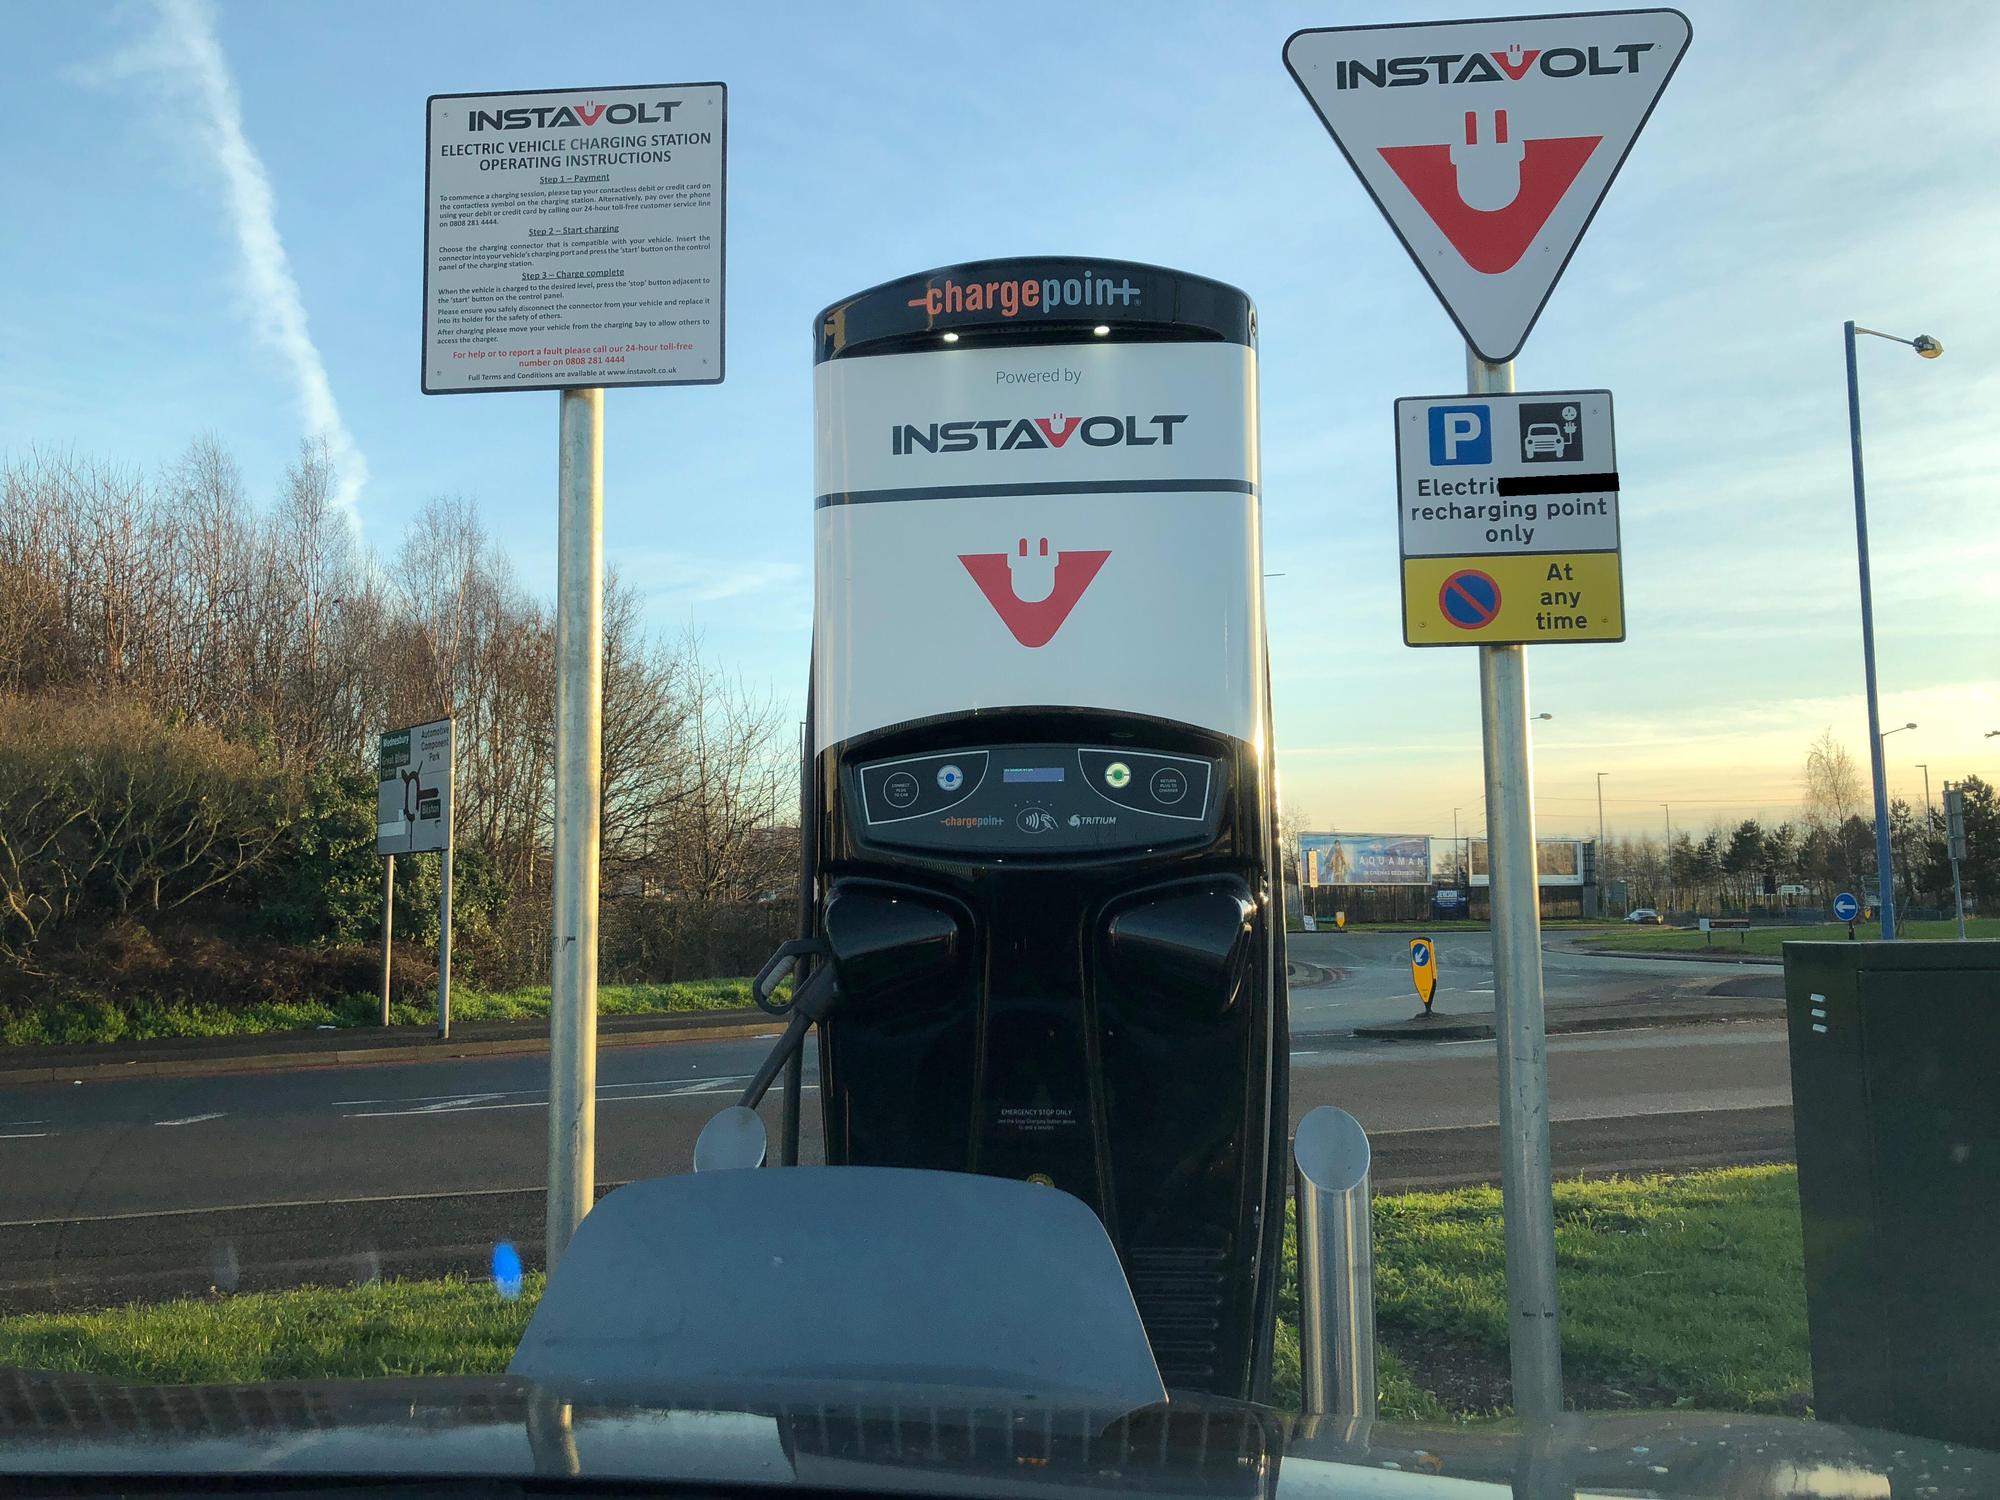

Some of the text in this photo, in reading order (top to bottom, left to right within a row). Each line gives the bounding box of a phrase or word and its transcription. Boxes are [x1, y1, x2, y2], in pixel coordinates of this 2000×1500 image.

[1336, 43, 1655, 90] INSTAVOLT
[469, 100, 683, 131] INSTAVOLT
[441, 132, 711, 157] ELECTRIC VEHICLE CHARGING STATION
[479, 150, 672, 171] OPERATING INSTRUCTIONS
[540, 176, 557, 185] Step
[574, 174, 610, 183] Payment
[491, 201, 515, 209] symbol
[541, 198, 572, 206] charging
[689, 192, 711, 200] phone
[440, 212, 457, 220] using
[548, 207, 569, 215] calling
[529, 228, 546, 237] Step
[563, 226, 582, 234] Start
[585, 225, 619, 234] charging
[522, 272, 539, 281] Step
[556, 270, 584, 280] Charge
[587, 269, 625, 278] complete
[502, 285, 528, 293] charged
[672, 278, 701, 286] adjacent
[908, 271, 1141, 316] chargepoint
[509, 314, 528, 322] safety
[456, 327, 484, 336] charging
[604, 322, 632, 330] charging
[635, 321, 646, 329] bay
[468, 351, 486, 359] help
[509, 349, 536, 358] report
[564, 347, 591, 356] please
[625, 344, 658, 352] 24-hour
[660, 343, 693, 351] toll-free
[565, 357, 586, 365] 0808
[607, 367, 677, 375] www.instavolt.co.uk
[995, 368, 1082, 384] Powered by
[892, 412, 1189, 455] INSTAVOLT
[1443, 412, 1482, 460] P
[1417, 478, 1508, 497] Electri
[1411, 497, 1608, 522] recharging point
[1485, 523, 1535, 545] only
[1546, 563, 1574, 581] At
[1540, 590, 1581, 608] any
[1536, 612, 1588, 630] time
[421, 726, 449, 738] Automotive
[383, 735, 409, 747] Wednesbury
[421, 737, 449, 751] Component
[429, 752, 440, 761] Park
[940, 815, 1004, 827] chargepoint
[1081, 816, 1117, 825] TRITIUM
[1359, 855, 1424, 866] AQUAMAN
[1001, 1108, 1072, 1116] EMERGENCY STOP ONLY
